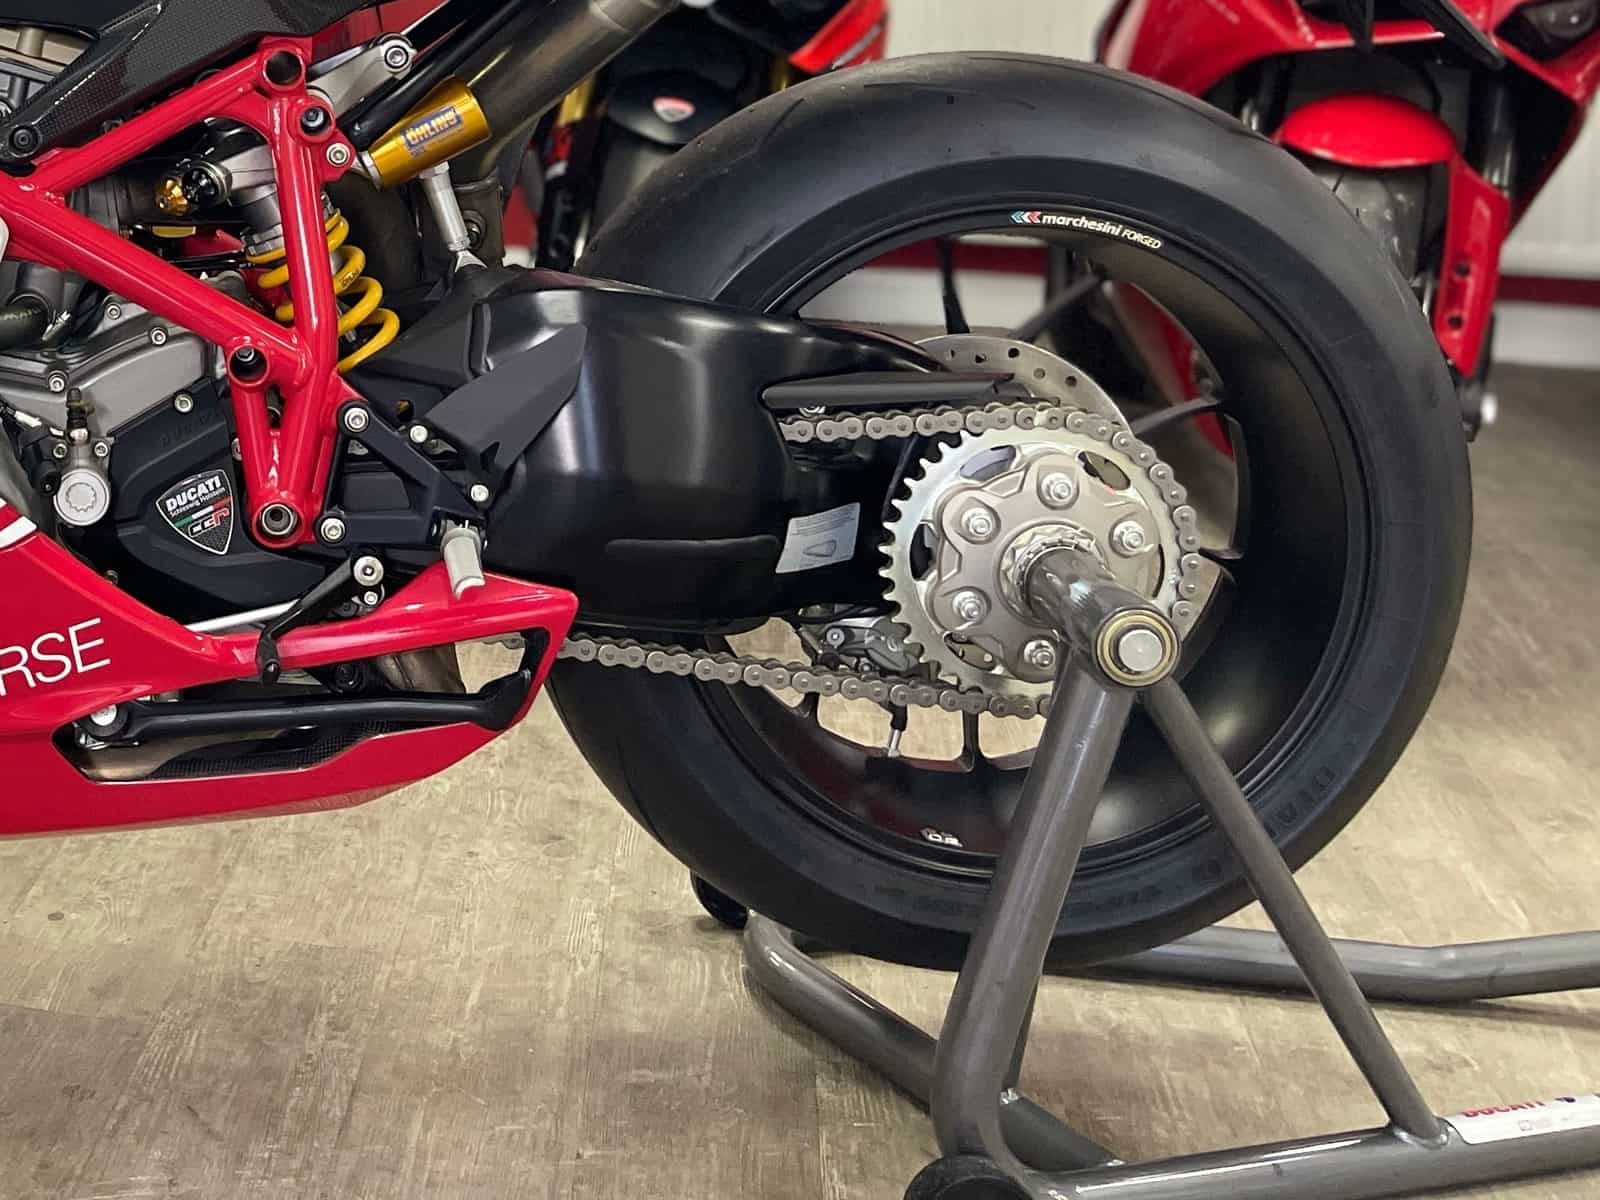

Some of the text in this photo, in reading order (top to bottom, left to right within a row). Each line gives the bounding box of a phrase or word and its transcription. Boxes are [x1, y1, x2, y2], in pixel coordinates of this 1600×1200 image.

[1041, 215, 1162, 249] marchesini FORGED
[165, 475, 221, 512] DUCATI
